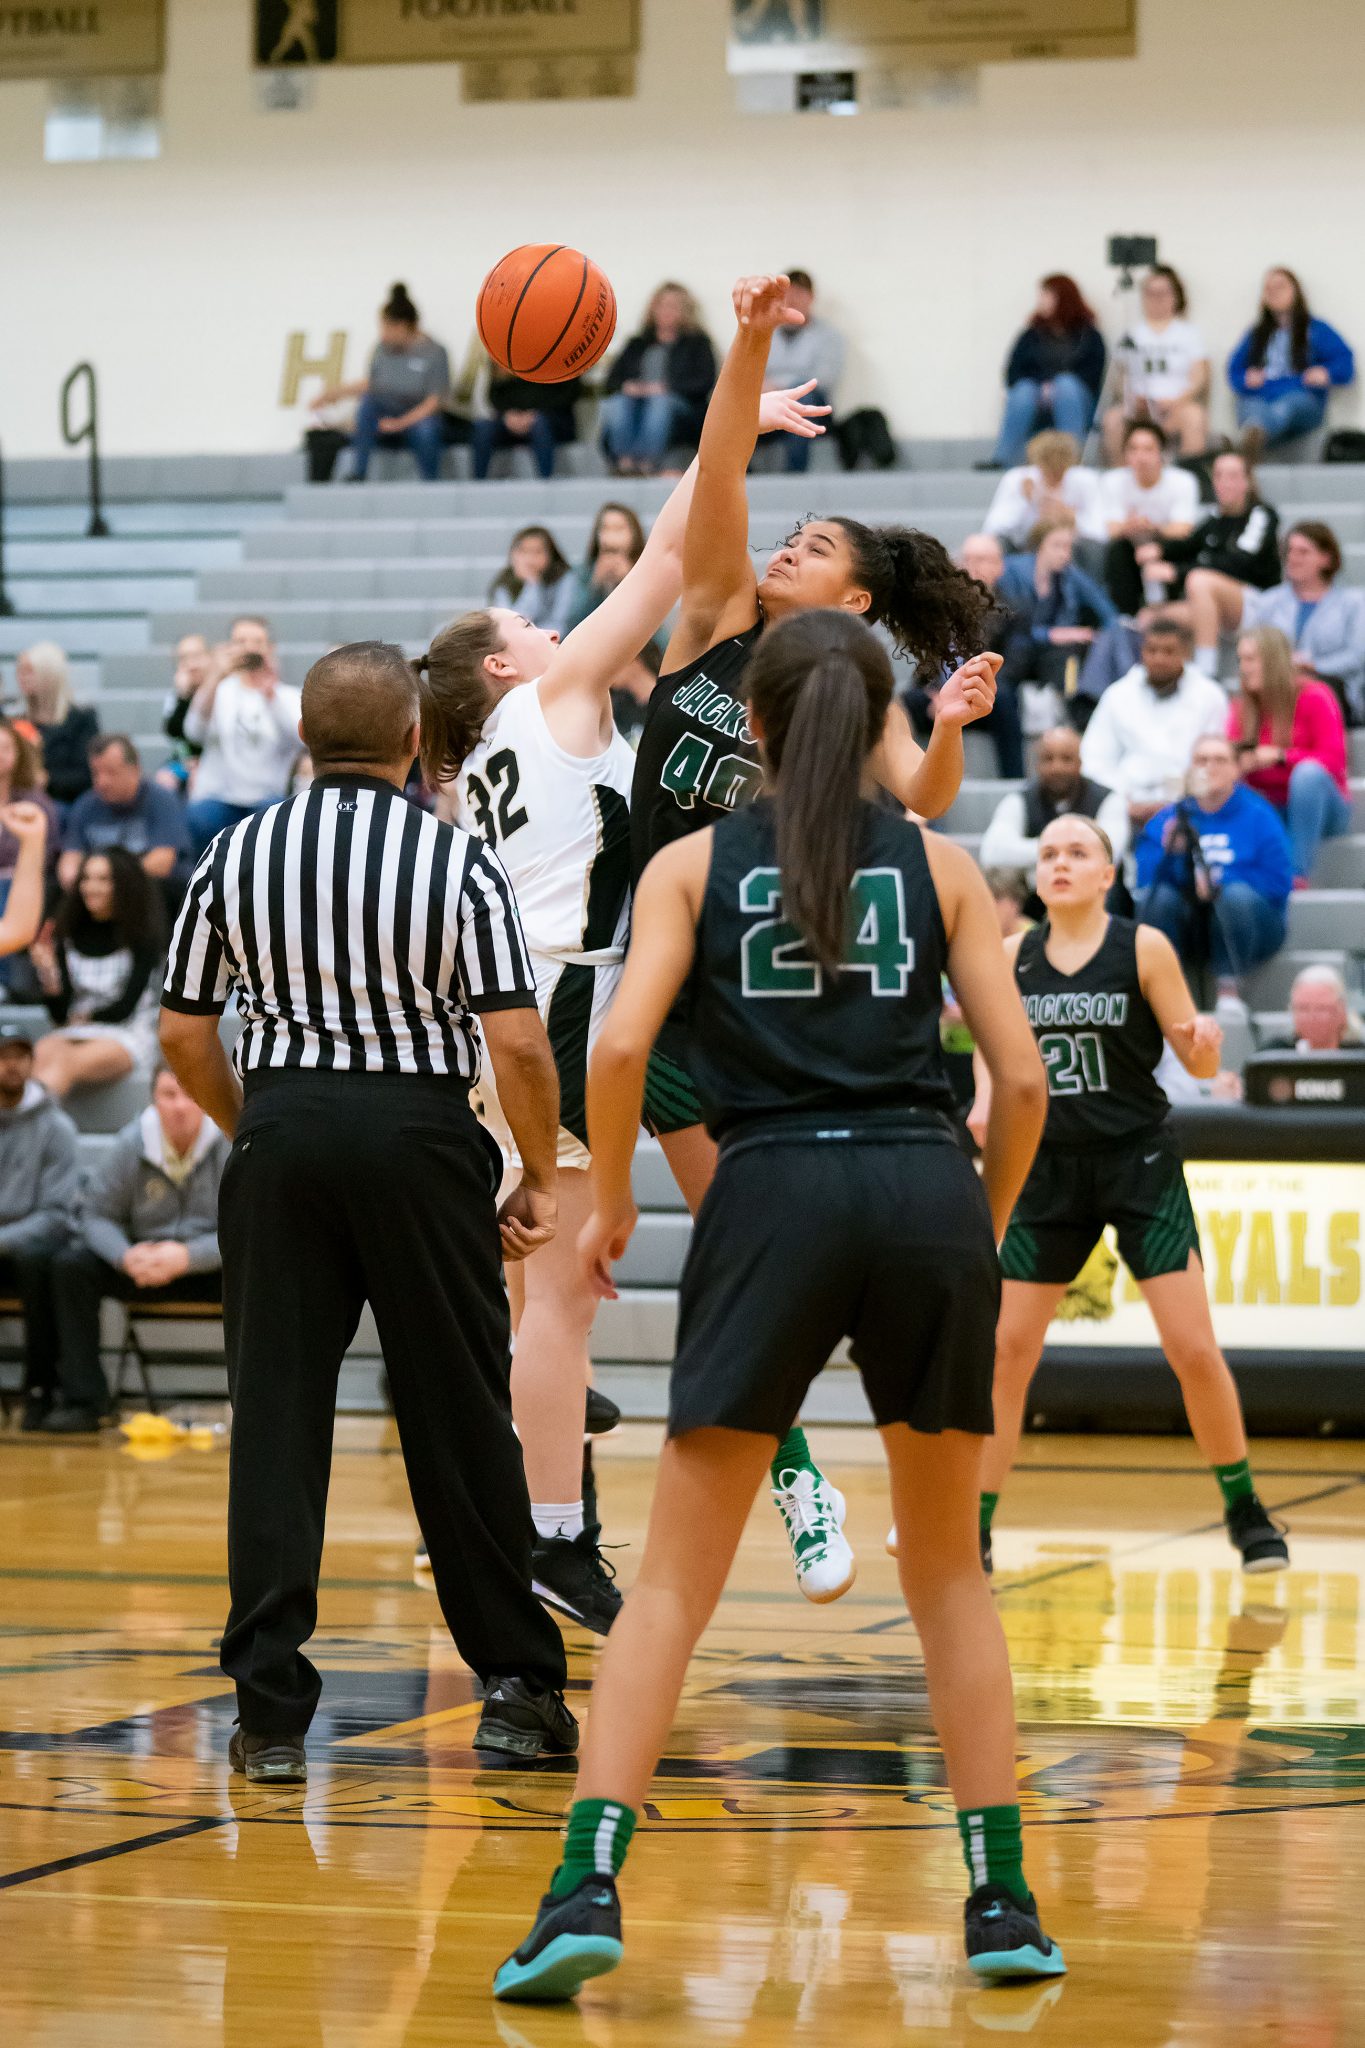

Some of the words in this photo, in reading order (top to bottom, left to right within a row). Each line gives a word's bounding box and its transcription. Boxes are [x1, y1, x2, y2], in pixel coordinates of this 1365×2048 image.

[0, 8, 99, 37] TBALL
[466, 747, 529, 849] 32
[660, 731, 765, 811] 40
[739, 866, 915, 998] 24
[1038, 1032, 1108, 1097] 21
[1122, 1210, 1361, 1306] YALS
